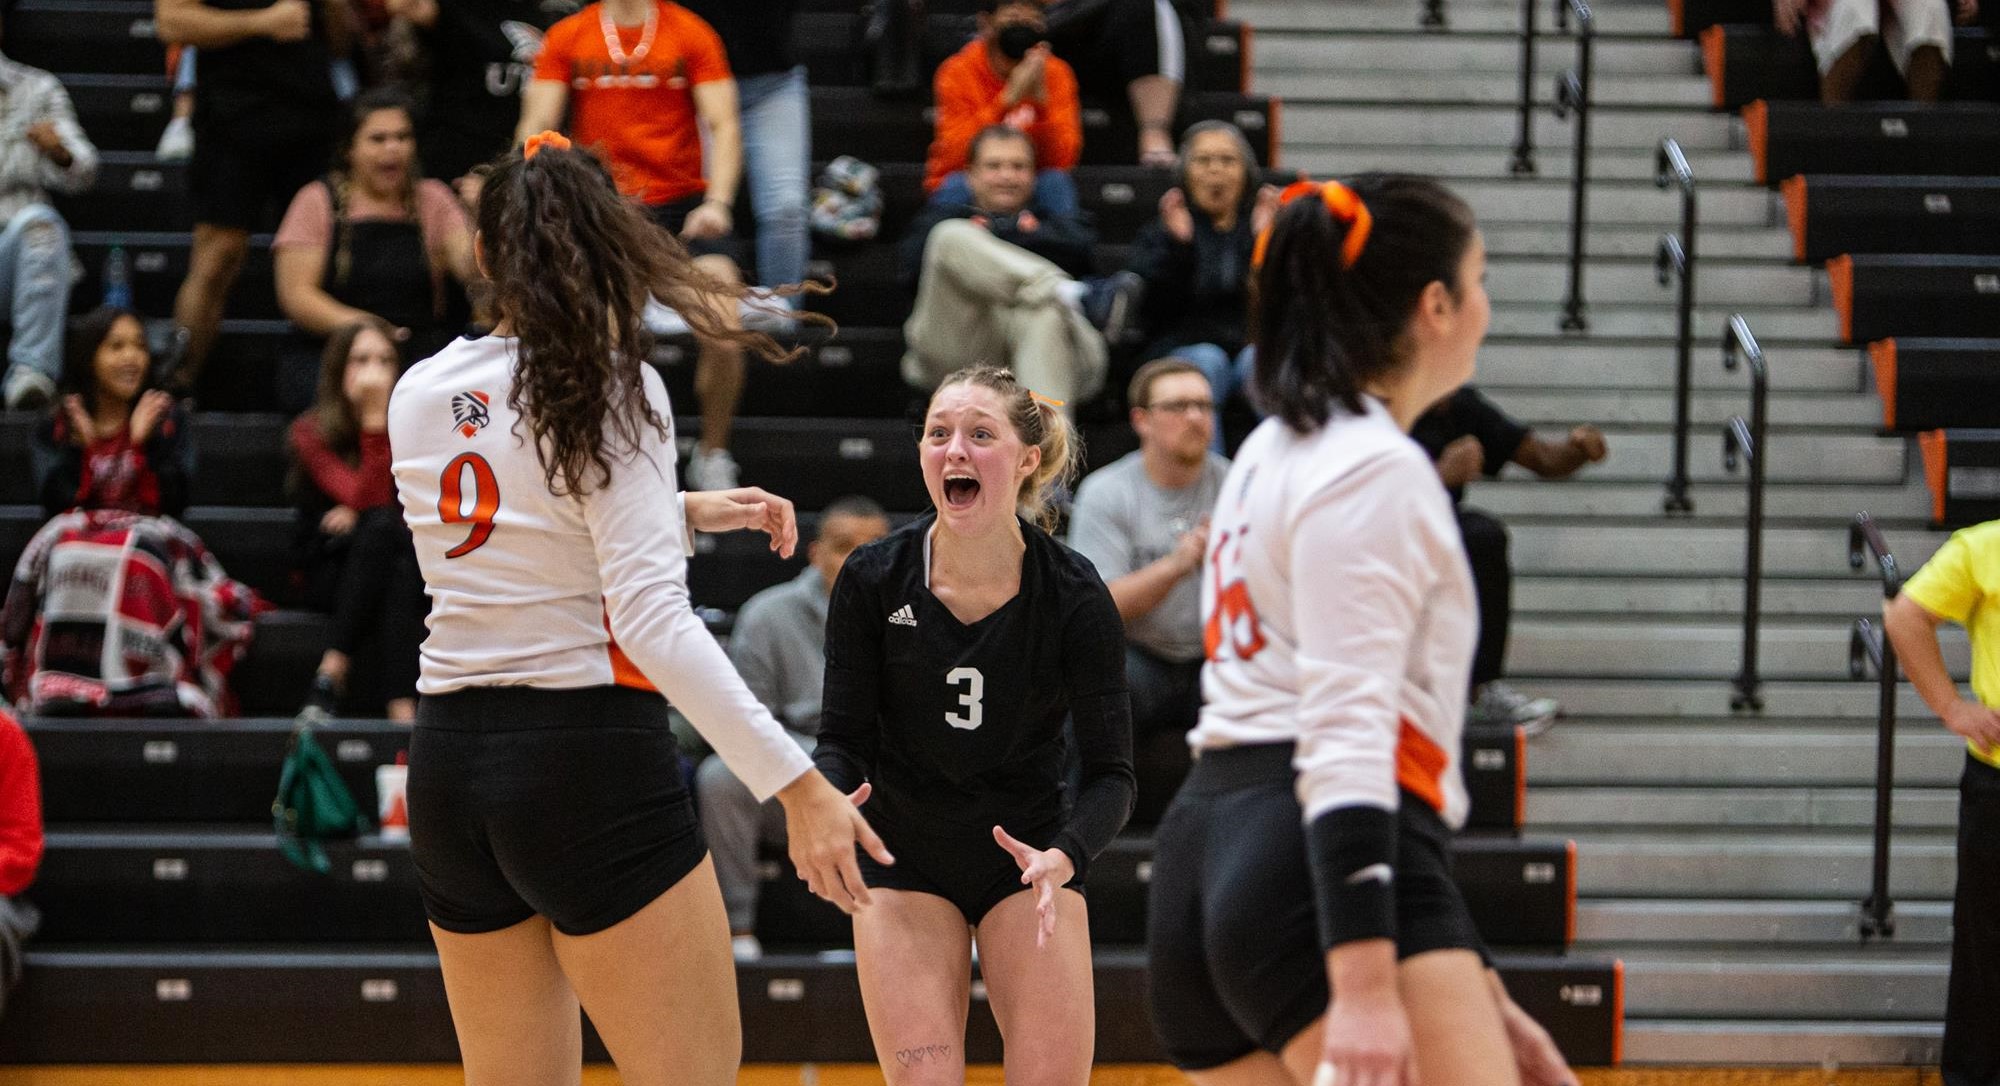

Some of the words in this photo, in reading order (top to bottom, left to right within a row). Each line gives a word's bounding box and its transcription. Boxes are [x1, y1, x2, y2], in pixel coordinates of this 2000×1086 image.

[438, 452, 500, 559] 9
[888, 616, 917, 627] adidas
[945, 667, 984, 730] 3
